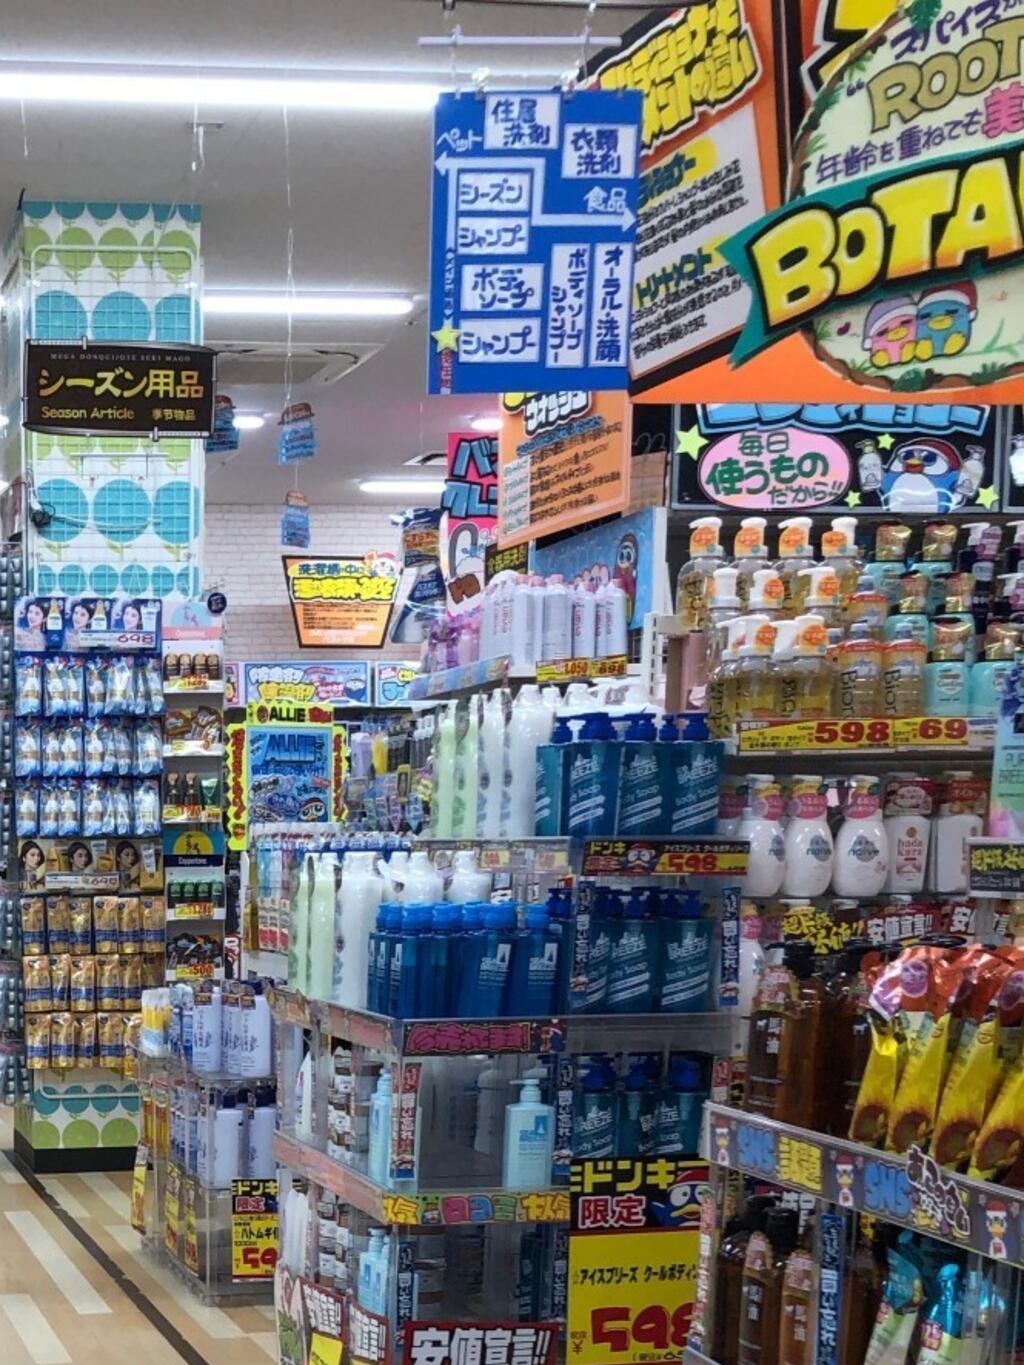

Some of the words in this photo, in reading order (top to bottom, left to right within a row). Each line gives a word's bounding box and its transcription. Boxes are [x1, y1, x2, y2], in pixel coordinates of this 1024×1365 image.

[436, 127, 482, 151] ペット
[571, 128, 619, 152] 衣類
[460, 178, 523, 202] シーズン
[458, 225, 527, 248] シャンプー
[753, 152, 1024, 330] BOTA
[472, 268, 523, 293] ボディ
[479, 286, 535, 309] ソープ
[568, 249, 588, 350] ボディソープ
[549, 286, 569, 363] シャンプー
[461, 325, 536, 355] シャンプー
[38, 365, 204, 399] シーズン用品
[41, 405, 88, 420] Season
[90, 406, 135, 421] Article
[738, 431, 790, 456] 毎日
[705, 451, 830, 497] 使うもの
[767, 480, 845, 505] だから!!
[116, 633, 155, 644] 698
[269, 706, 307, 722] ALLIE
[814, 721, 890, 744] 598
[918, 718, 967, 740] 69
[590, 842, 626, 856] ドンキ
[668, 854, 719, 871] 598
[238, 1181, 278, 1195] ドンキ
[584, 1159, 676, 1193] ドンキ
[579, 1194, 646, 1229] 限定
[591, 1302, 696, 1354] 598
